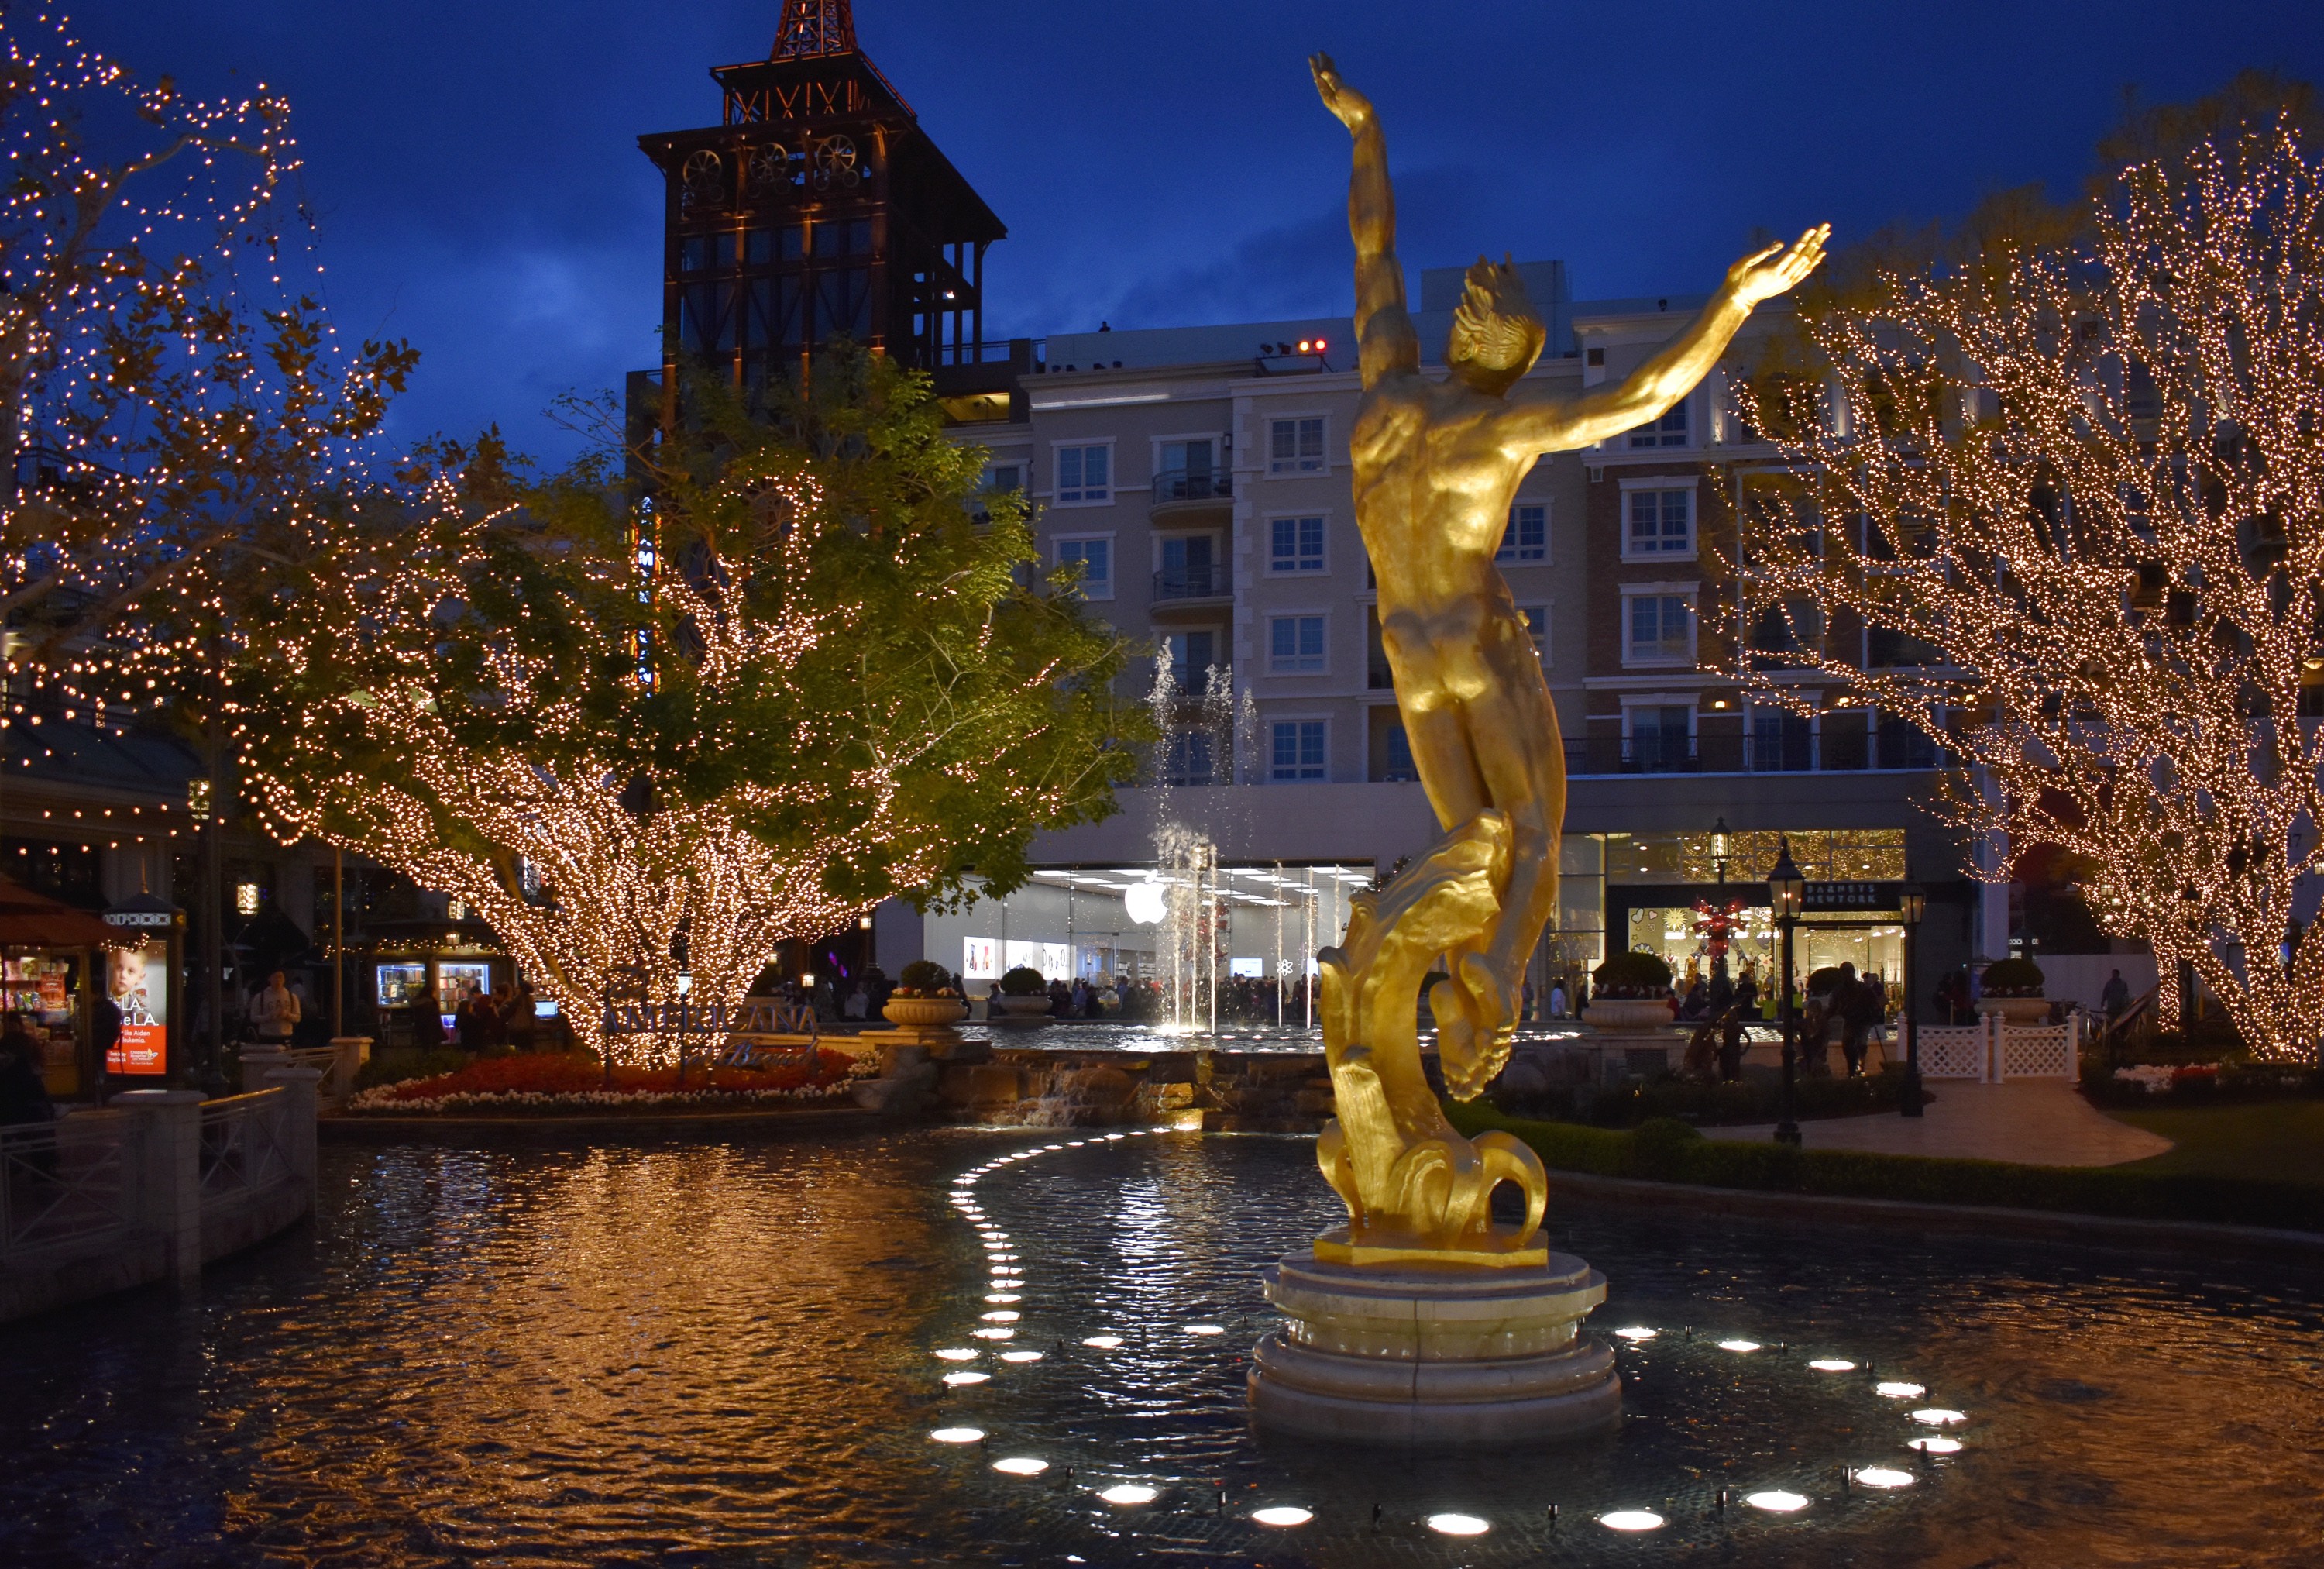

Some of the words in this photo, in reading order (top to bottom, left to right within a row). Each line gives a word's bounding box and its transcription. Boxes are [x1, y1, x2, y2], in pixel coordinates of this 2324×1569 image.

[1807, 885, 1875, 893] BARNEYS
[133, 1012, 160, 1027] L.A.
[600, 1005, 819, 1033] AMERICANA
